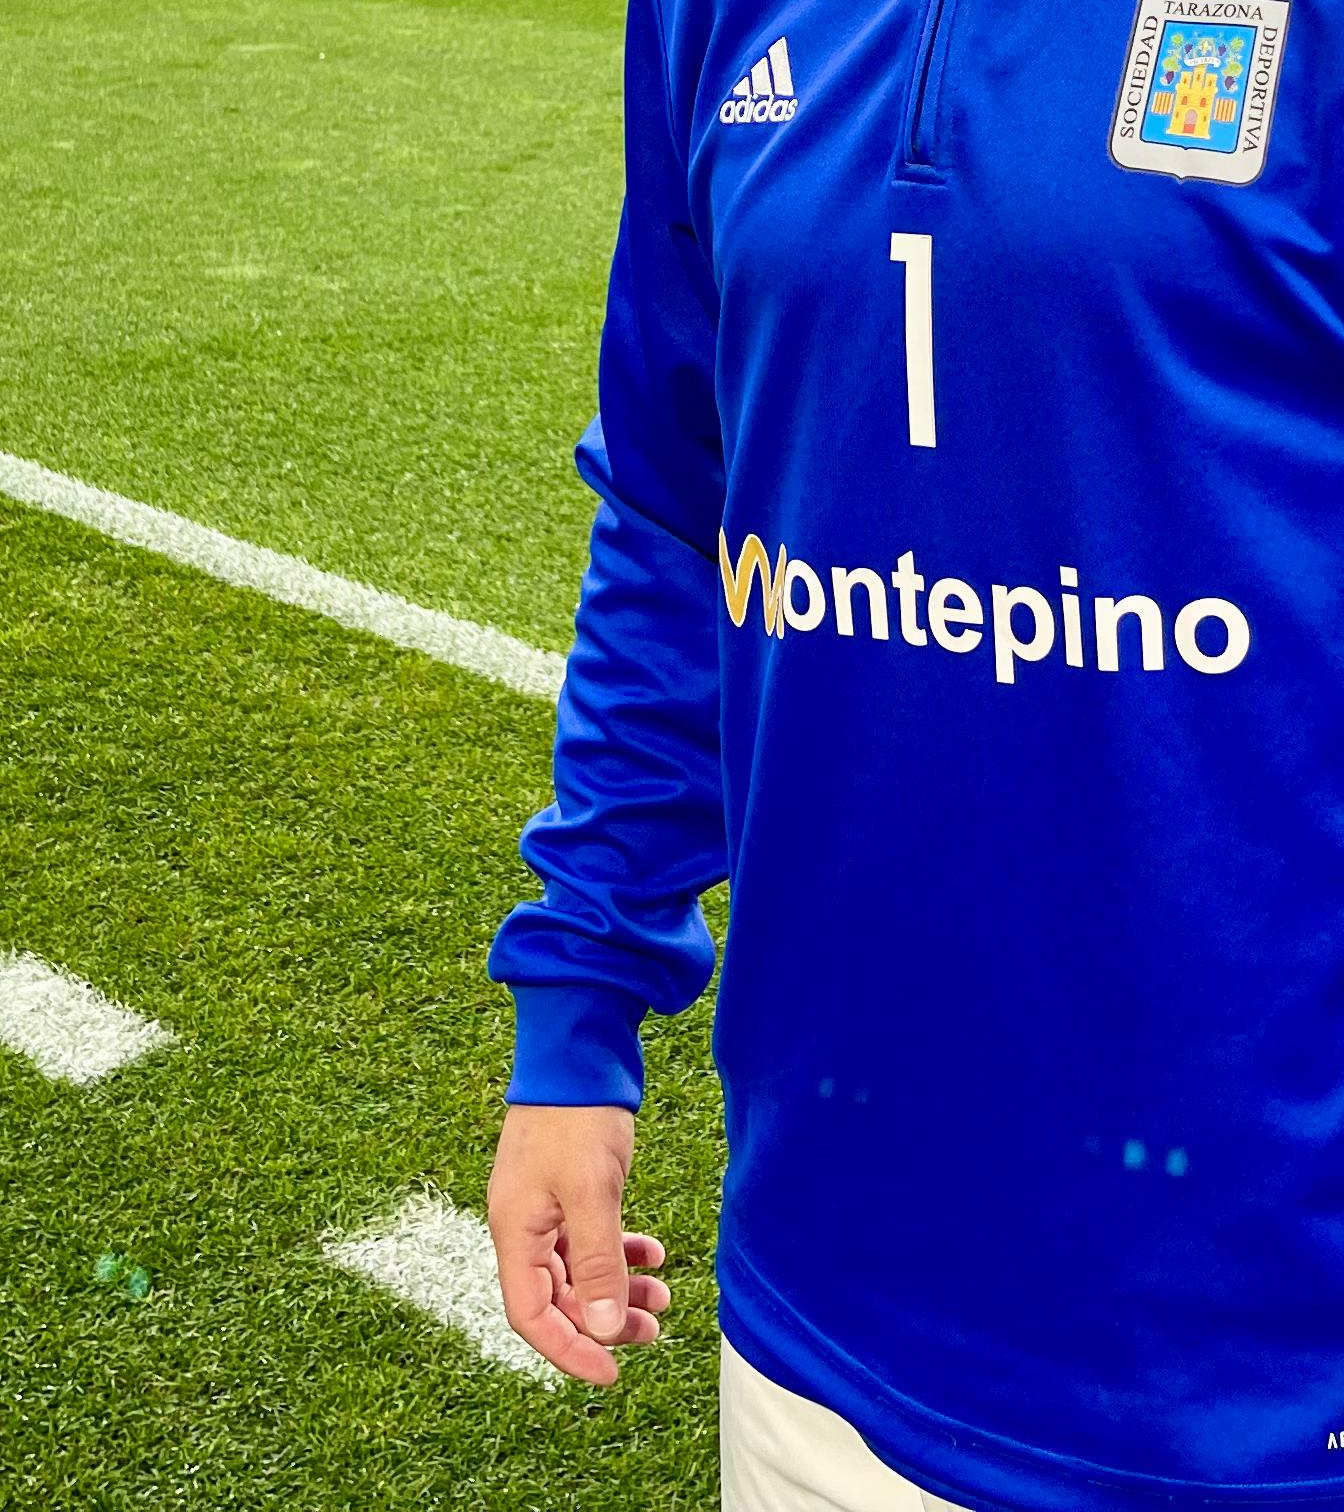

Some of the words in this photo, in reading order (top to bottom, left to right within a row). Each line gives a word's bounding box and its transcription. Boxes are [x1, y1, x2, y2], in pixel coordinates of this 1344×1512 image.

[1163, 0, 1264, 21] TARAZONA
[719, 93, 798, 124] adidas
[1120, 15, 1158, 138] SOCIEDAD
[1242, 25, 1278, 153] DEPORTIVA
[890, 232, 937, 448] 1
[718, 525, 1250, 685] Montepino
